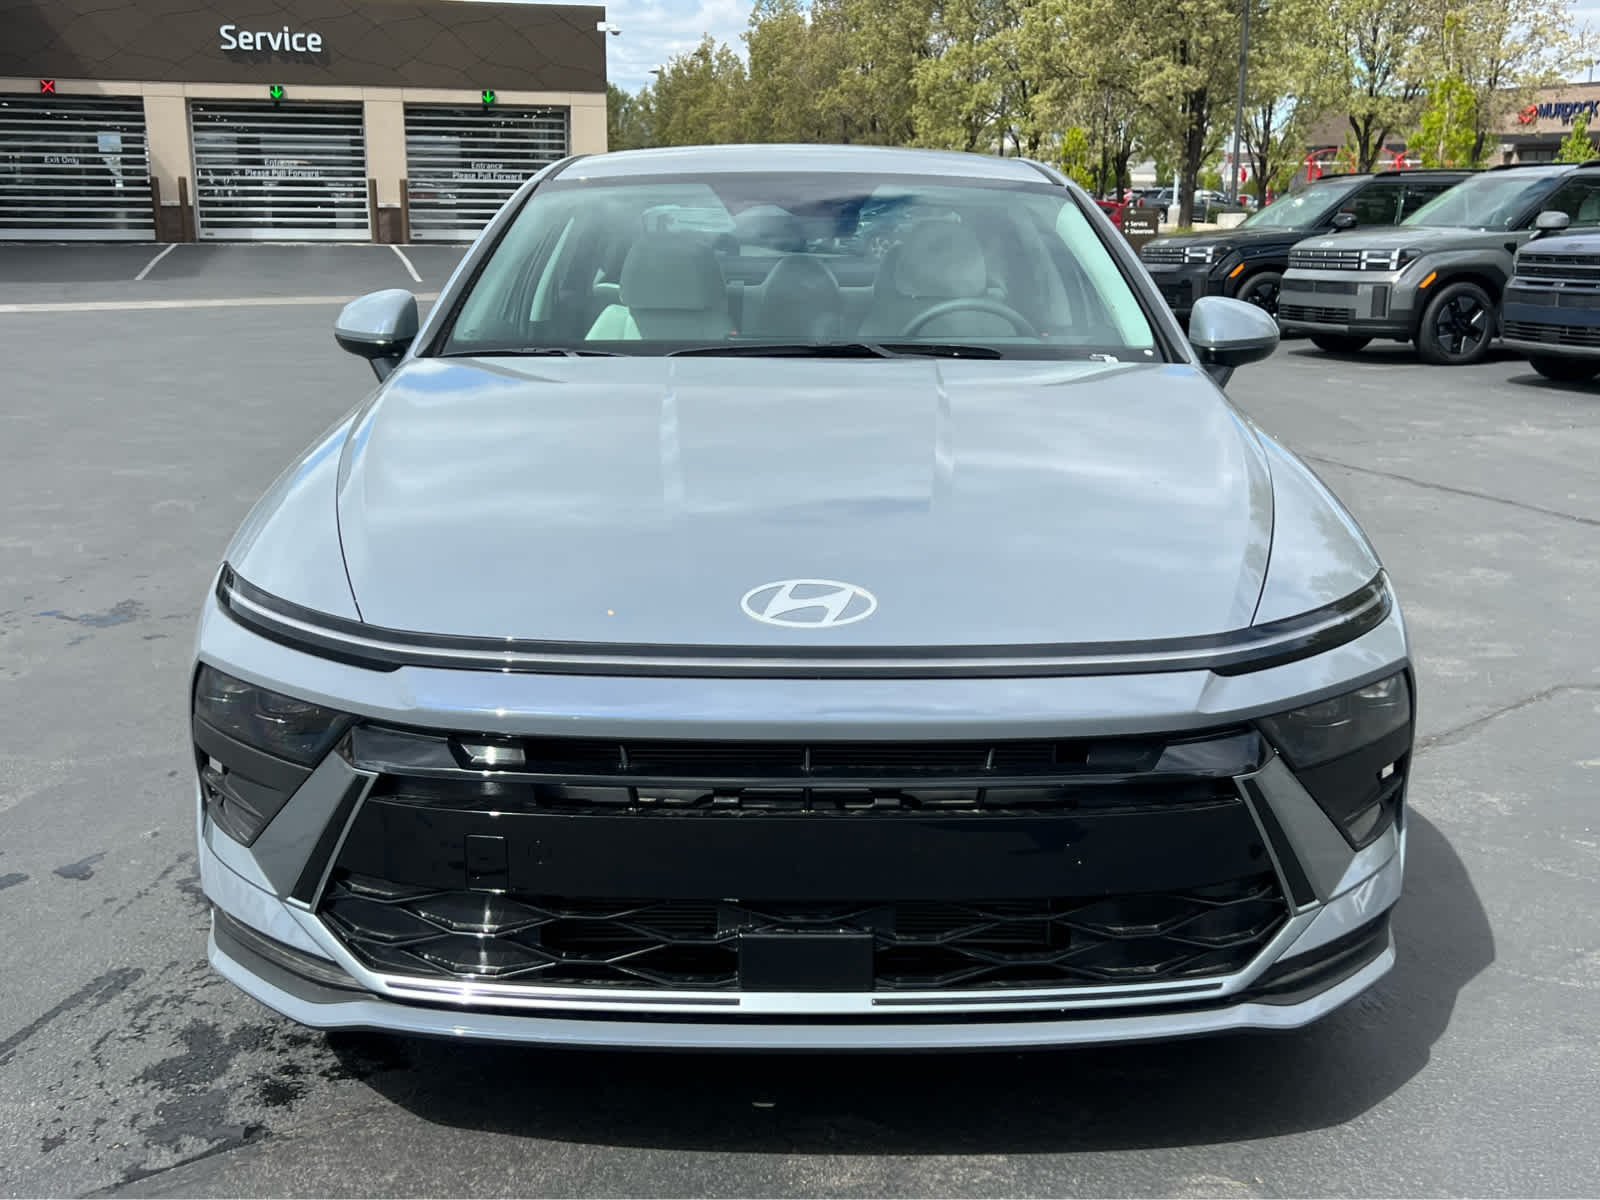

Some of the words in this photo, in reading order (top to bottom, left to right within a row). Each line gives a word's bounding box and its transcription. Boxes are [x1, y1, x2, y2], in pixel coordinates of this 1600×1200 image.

[219, 24, 322, 53] Service
[1539, 101, 1600, 119] MURDOCK
[44, 156, 60, 165] Exit
[62, 156, 79, 165] Only
[471, 161, 503, 170] Entrance
[452, 172, 475, 180] Please
[477, 172, 491, 180] Pull
[494, 172, 523, 181] Forward
